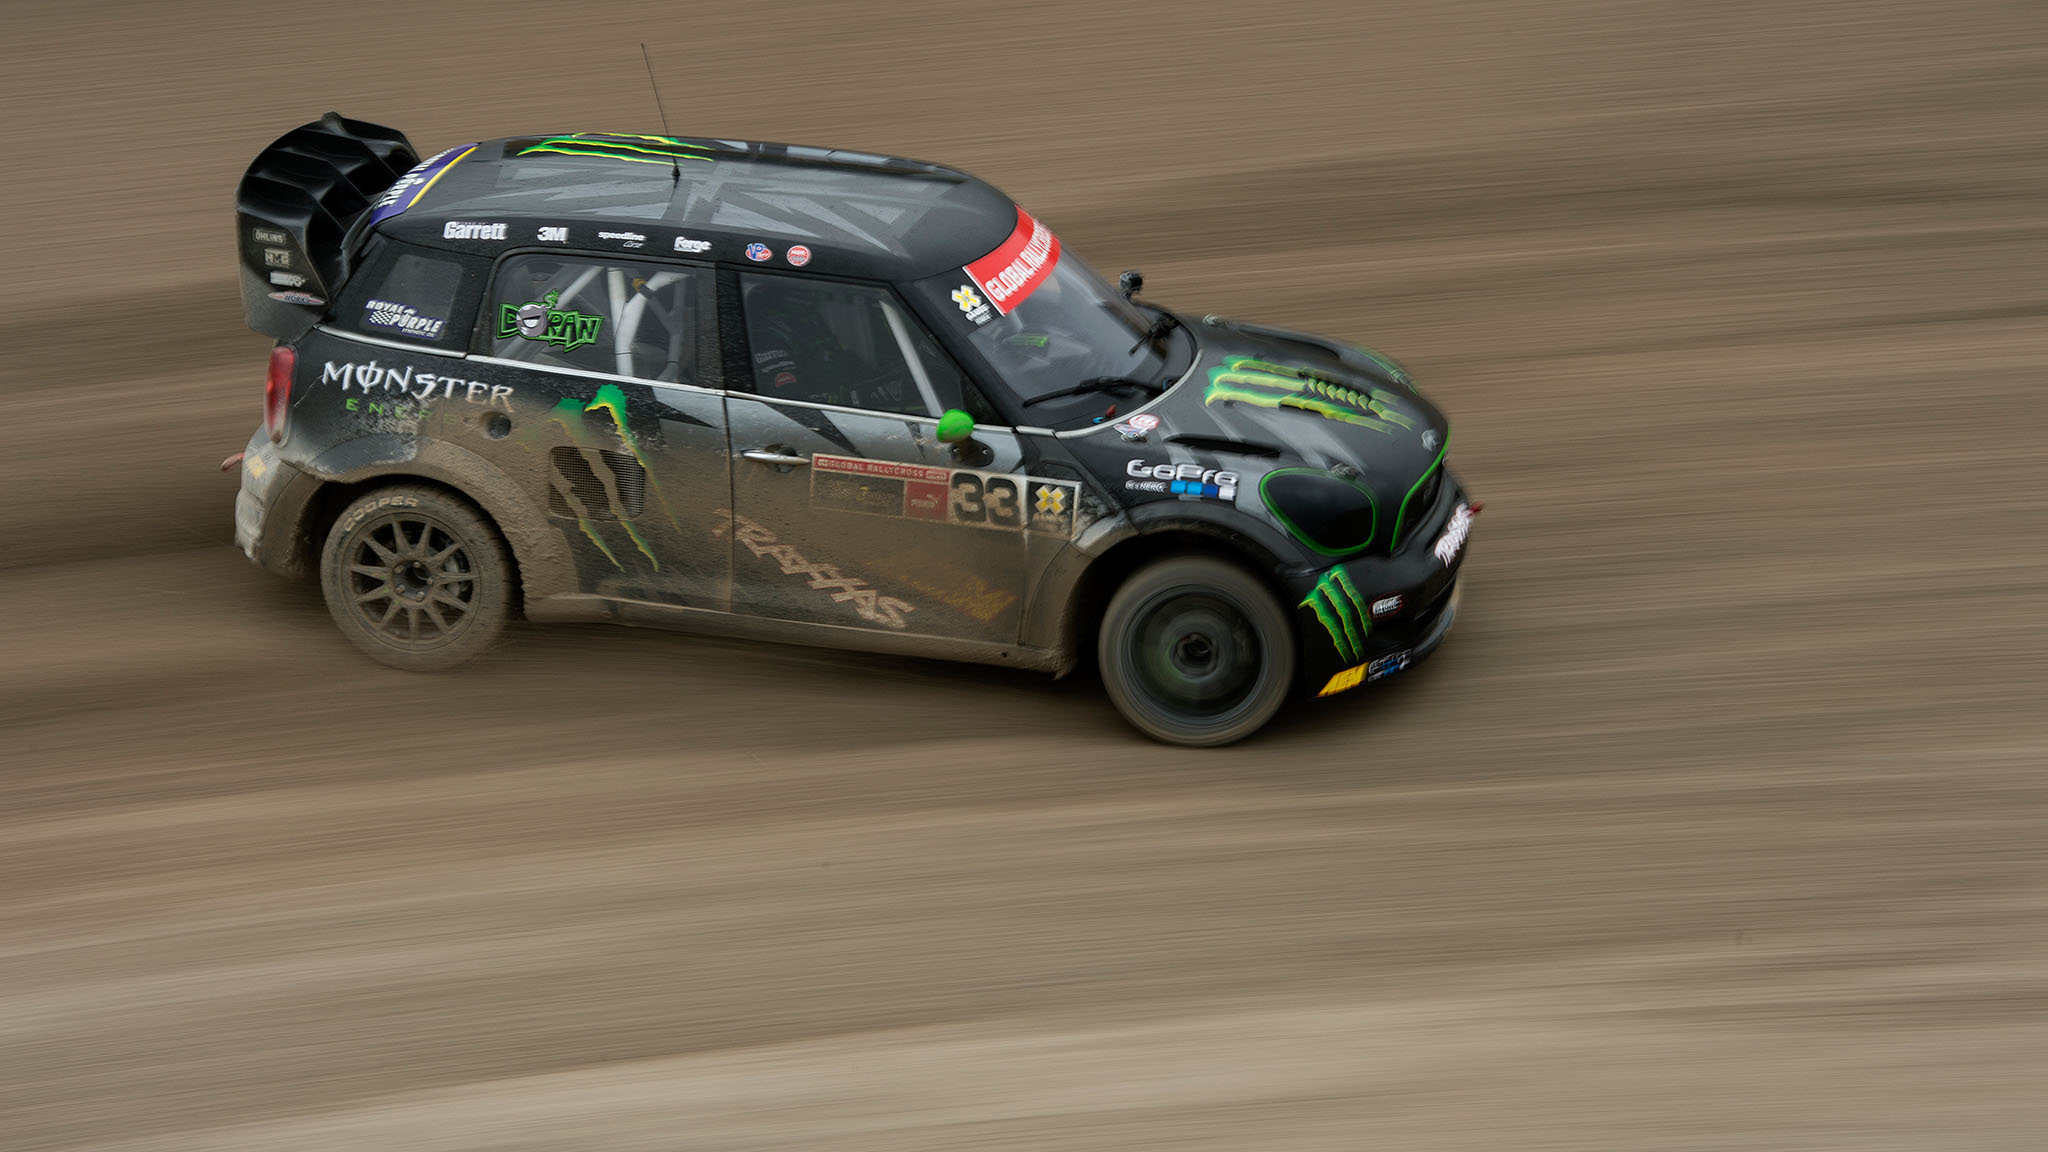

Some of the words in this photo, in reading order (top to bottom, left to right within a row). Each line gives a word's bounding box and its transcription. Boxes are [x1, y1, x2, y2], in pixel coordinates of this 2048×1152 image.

[443, 221, 509, 240] Garrett
[537, 226, 569, 242] 3M
[598, 232, 647, 242] speedline
[985, 257, 1036, 302] GLOBAL
[365, 300, 406, 314] ROYAL
[390, 313, 443, 333] PURPLE
[321, 360, 514, 413] MONSTER
[828, 459, 865, 471] GLOBAL
[866, 463, 924, 478] RALLYCROSS
[1126, 459, 1239, 488] GoPro
[951, 471, 1022, 526] 33
[343, 496, 419, 532] COOPER
[711, 508, 916, 628] TRAXXAS
